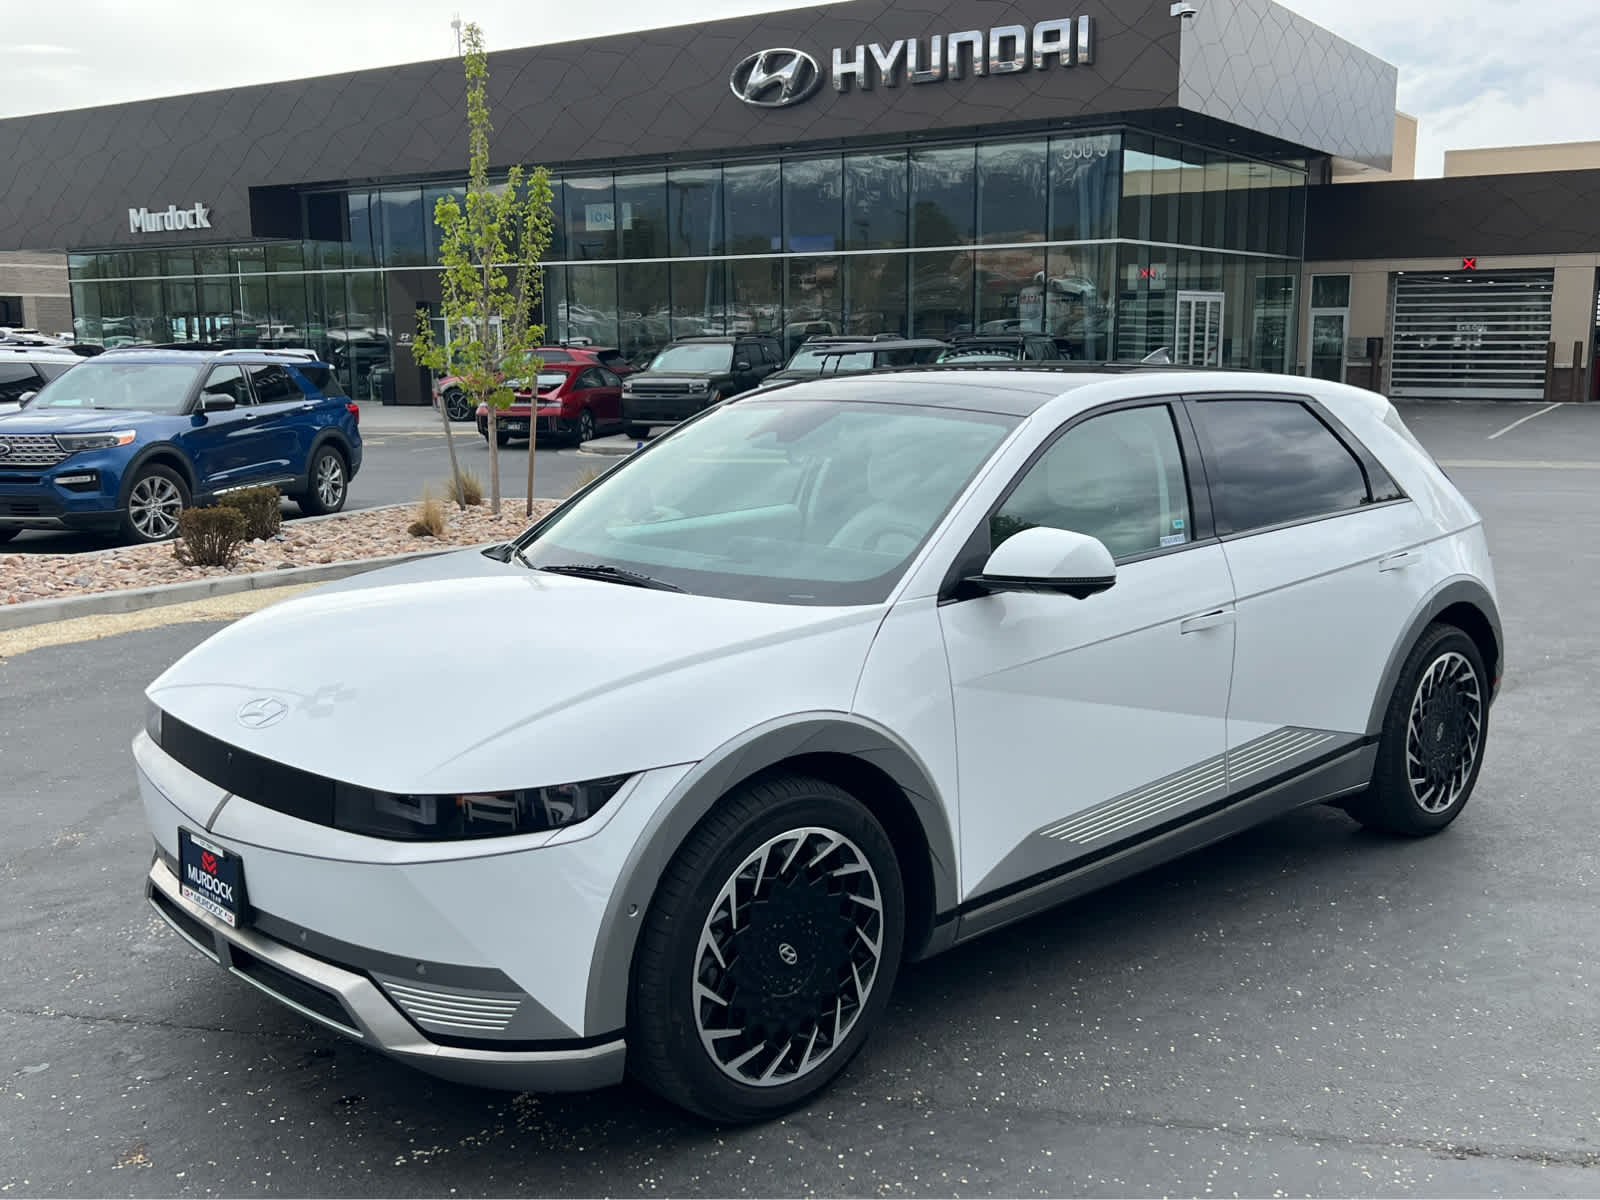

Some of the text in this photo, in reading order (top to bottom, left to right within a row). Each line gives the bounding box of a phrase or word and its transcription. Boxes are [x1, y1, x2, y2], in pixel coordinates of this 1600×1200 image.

[832, 14, 1095, 92] HYUNDAI
[128, 202, 211, 233] Murdock
[187, 863, 233, 902] MURDOCK
